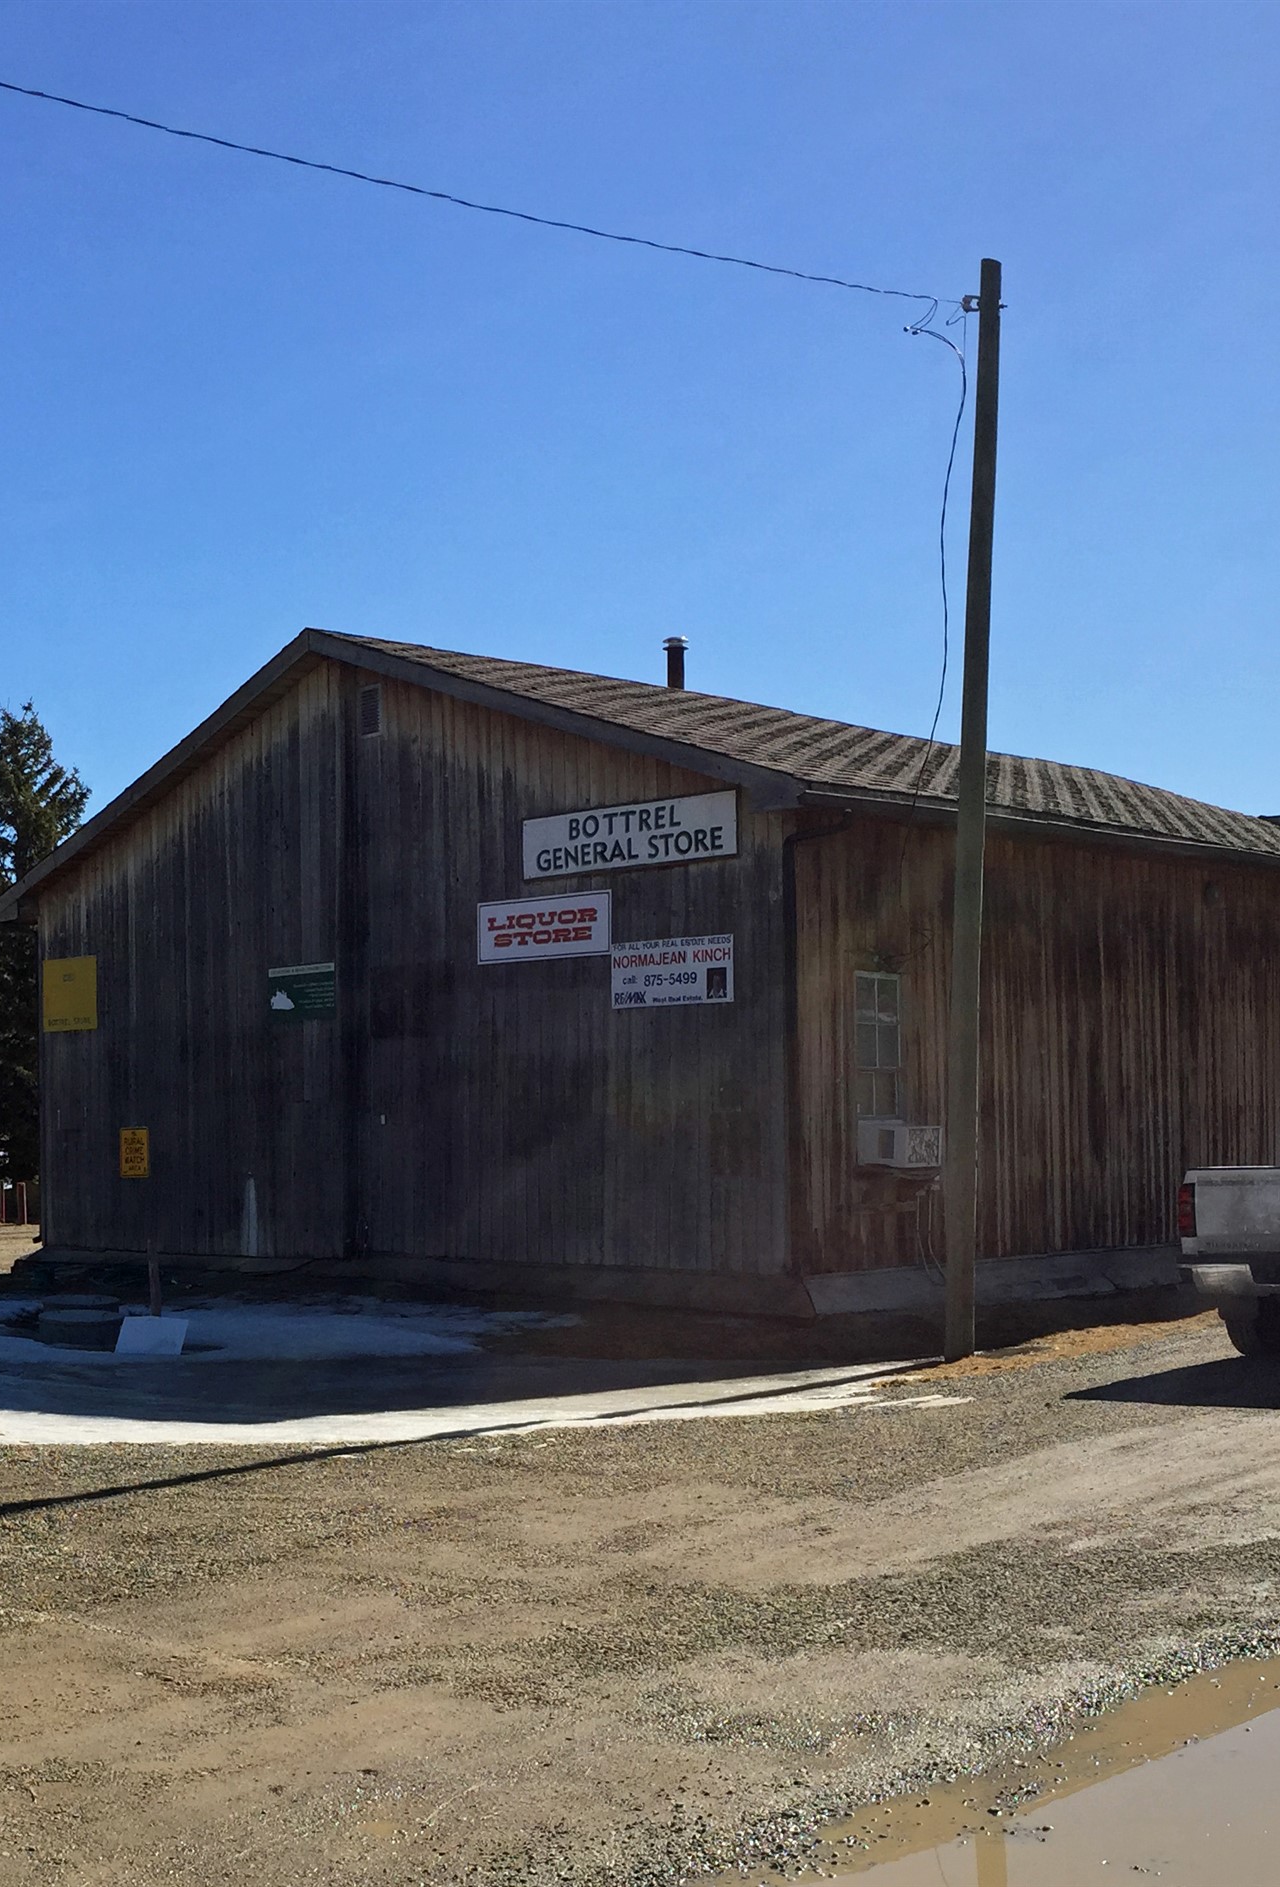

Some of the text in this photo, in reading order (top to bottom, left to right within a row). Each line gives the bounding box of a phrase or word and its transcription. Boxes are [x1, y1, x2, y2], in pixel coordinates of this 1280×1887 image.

[569, 805, 681, 841] BOTTREL
[536, 826, 724, 872] GENERAL STORE
[487, 907, 598, 931] LIQUOR
[494, 926, 592, 947] STORE
[642, 942, 660, 950] YOUR
[662, 940, 678, 948] REAL
[680, 938, 705, 947] ESTATE
[707, 936, 731, 945] NEEDS
[613, 947, 731, 969] NORMAJEAN KINCH
[643, 971, 698, 987] 875-5499
[614, 991, 646, 1005] RE/MAX
[124, 1137, 144, 1146] RURAL
[125, 1146, 144, 1155] CRIME
[125, 1156, 144, 1164] WATCH
